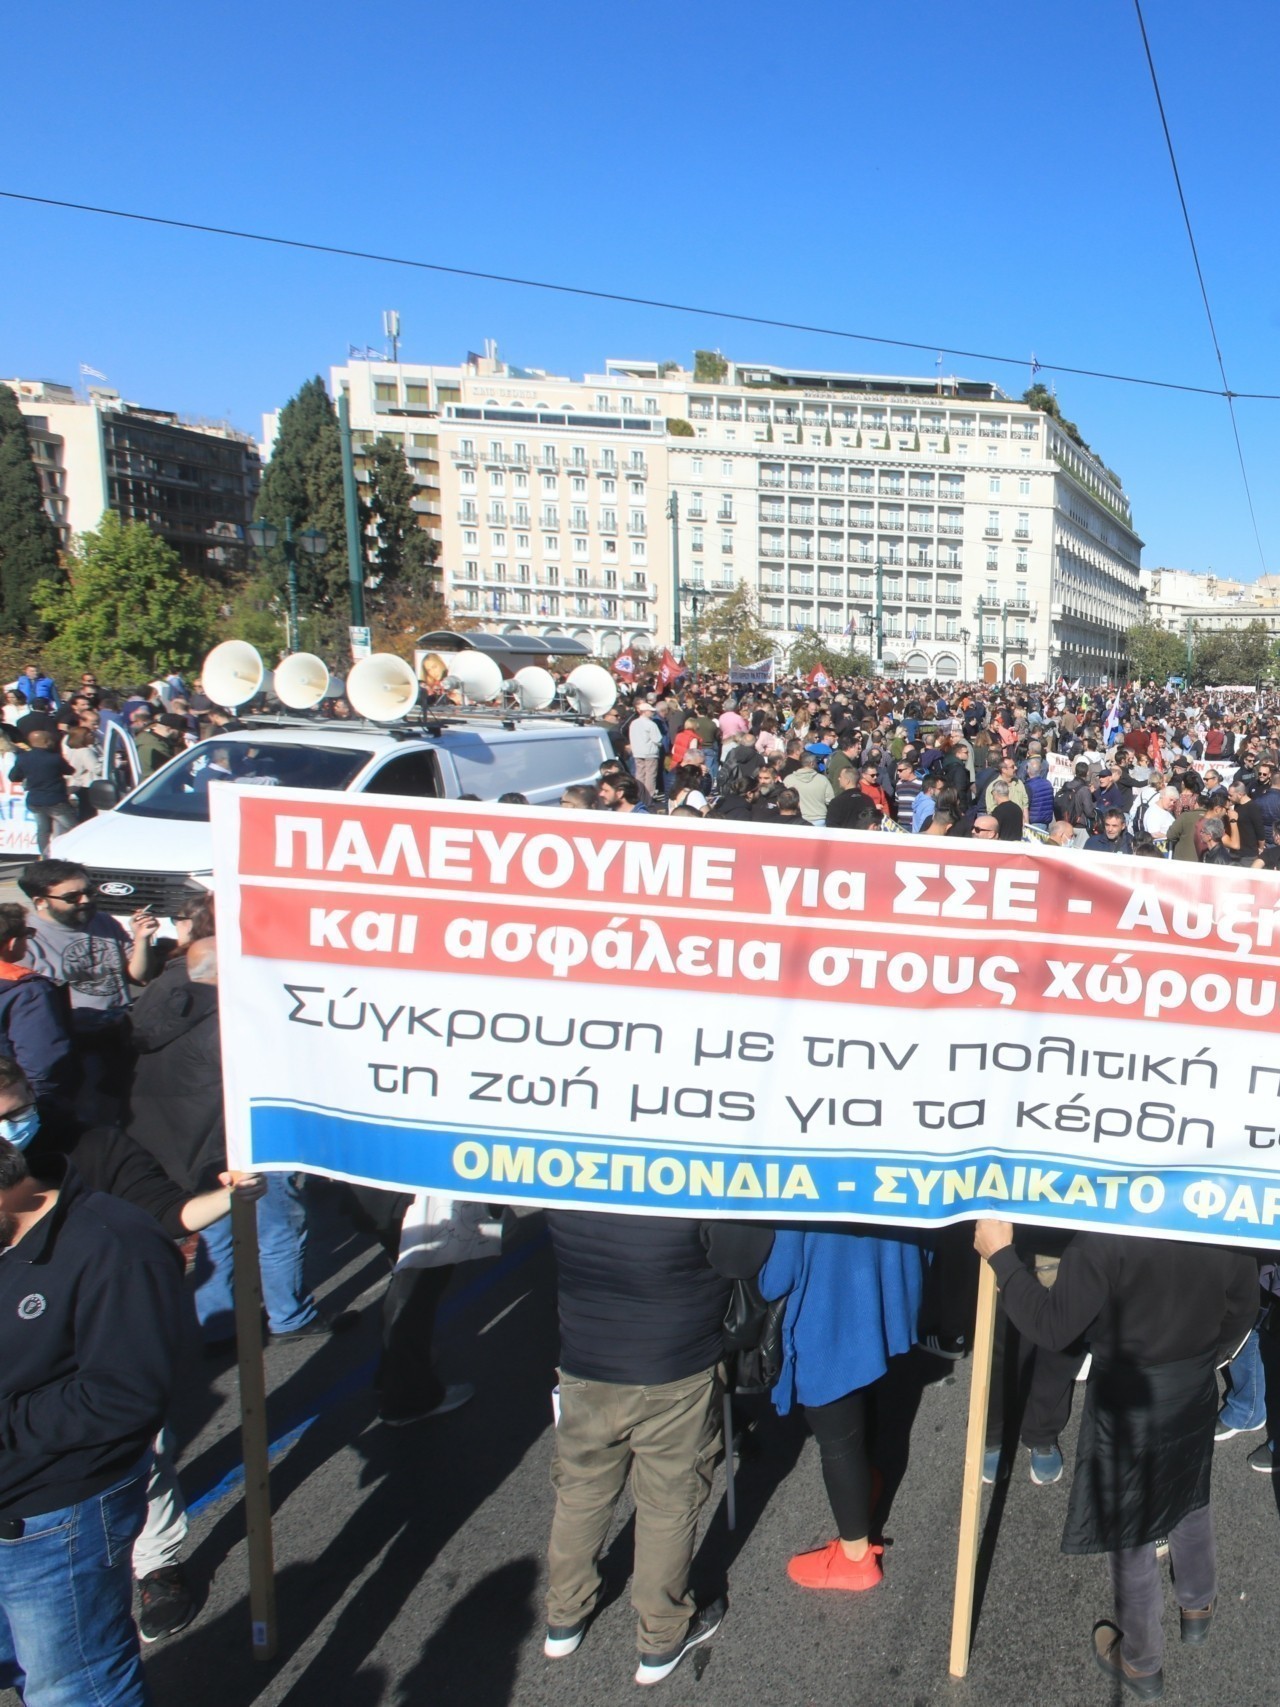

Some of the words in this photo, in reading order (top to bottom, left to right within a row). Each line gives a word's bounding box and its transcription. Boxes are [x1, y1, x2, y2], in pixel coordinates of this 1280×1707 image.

[274, 814, 735, 901] ΠΑΛΕΥΟΥΜΕ
[762, 864, 866, 915] για
[893, 864, 1040, 924] ΣΣΕ
[1067, 900, 1092, 914] -
[309, 907, 417, 954] και
[445, 914, 782, 981] ασφάλεια
[808, 945, 1016, 1008] στους
[284, 983, 663, 1054] Σύγκρουση
[695, 1028, 774, 1066] με
[804, 1035, 918, 1071] την
[950, 1036, 1218, 1089] πολιτική
[369, 1061, 439, 1097] τη
[469, 1066, 598, 1109] ζωή
[631, 1083, 755, 1122] μας
[786, 1094, 881, 1132] για
[914, 1101, 984, 1129] τα
[1016, 1093, 1214, 1149] κέρδη
[452, 1141, 819, 1200] ΟΜΟΣΠΟΝΔΙΑ
[837, 1183, 855, 1191] -
[873, 1163, 1165, 1217] ΣΥΝΔΙΚΑΤΟ
